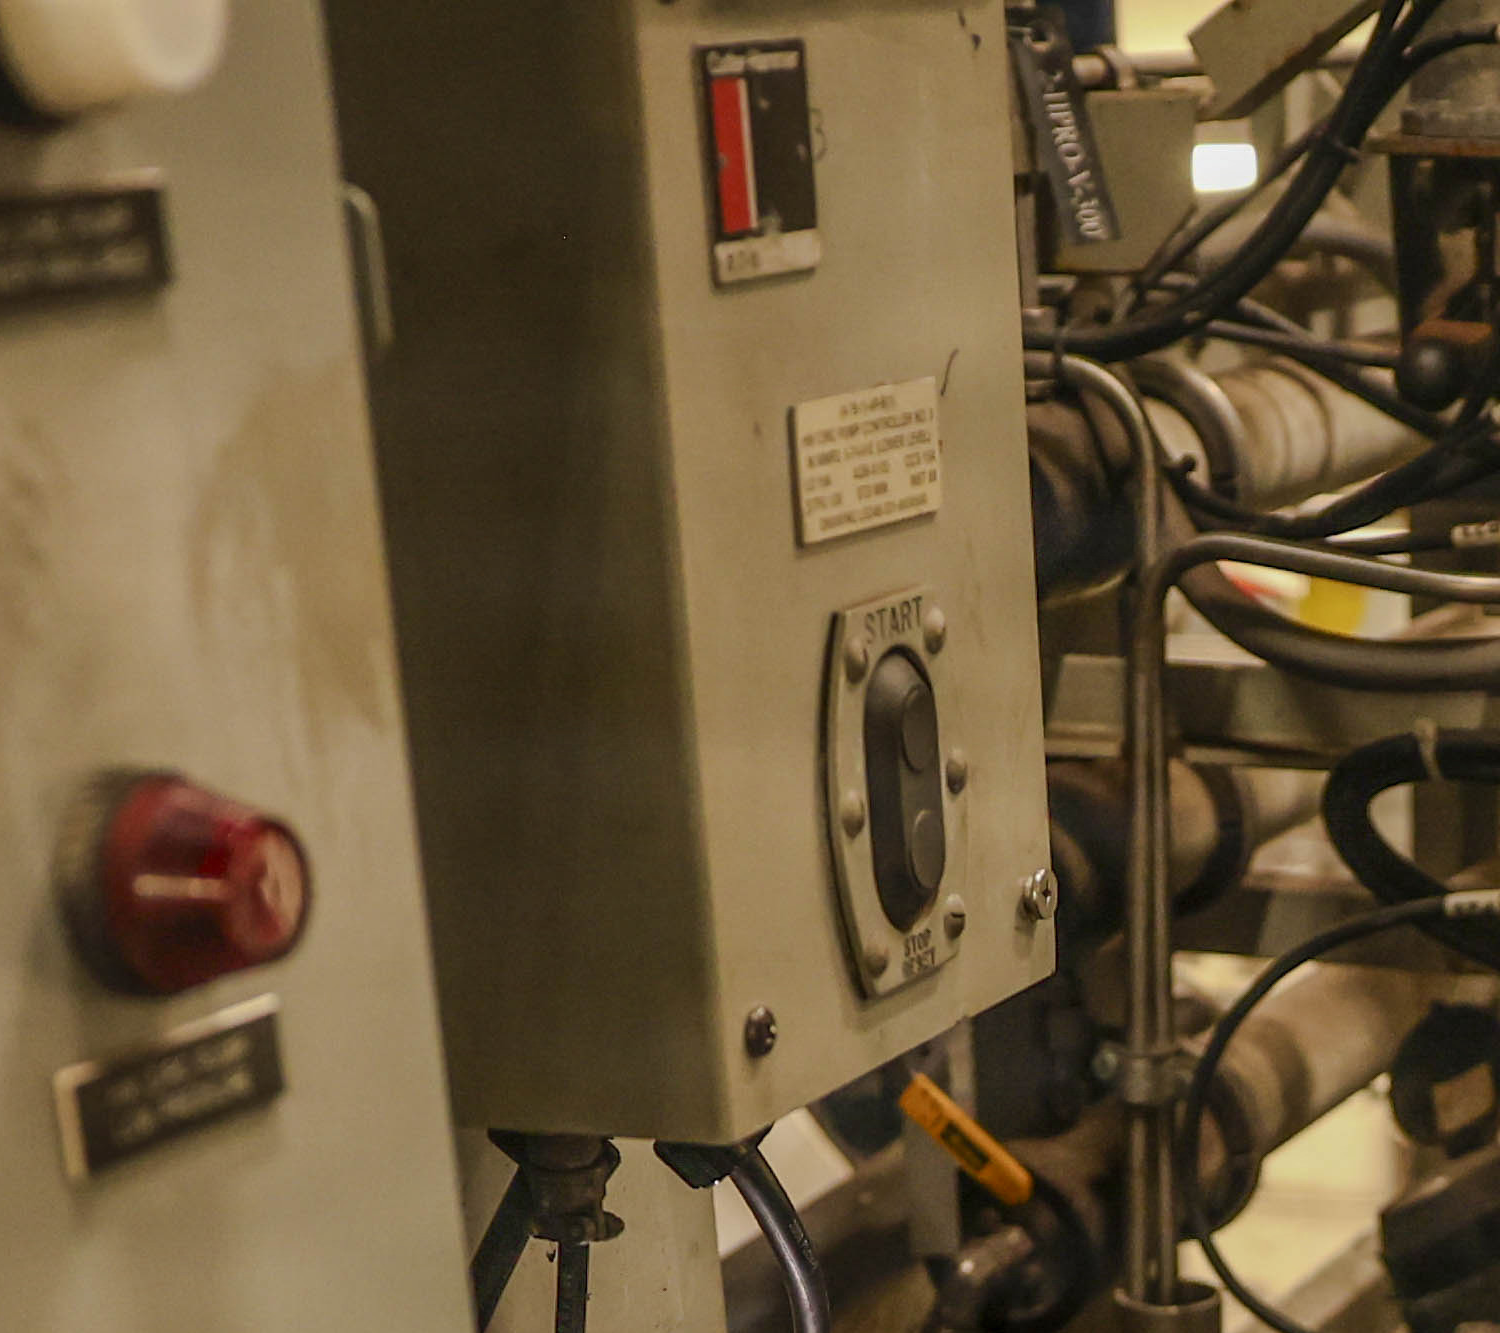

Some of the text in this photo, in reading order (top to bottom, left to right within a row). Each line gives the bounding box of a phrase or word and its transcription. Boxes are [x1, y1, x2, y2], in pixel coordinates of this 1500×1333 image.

[863, 595, 924, 645] START
[903, 928, 933, 957] STOP
[902, 953, 936, 978] RESET
